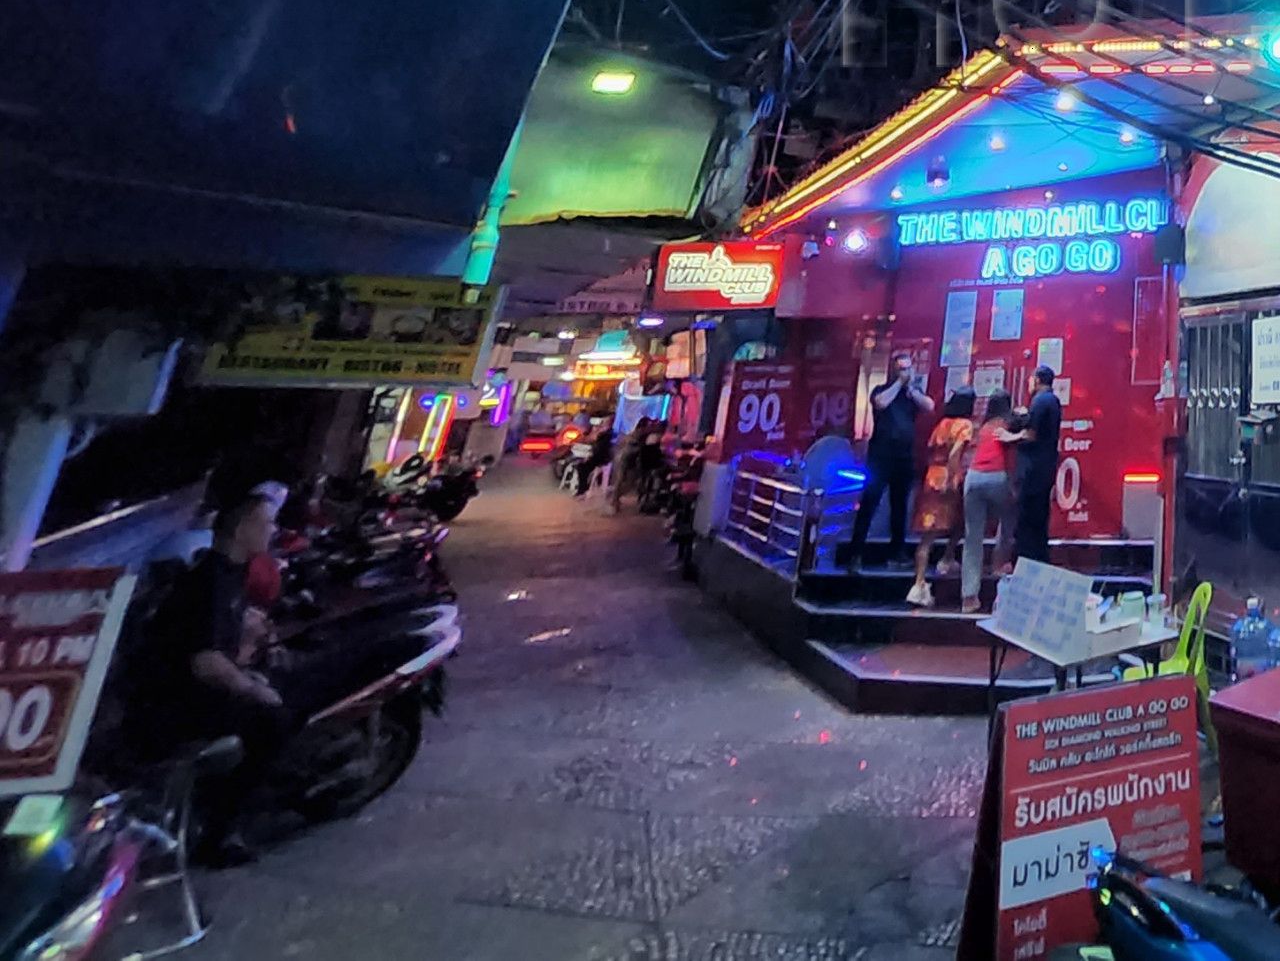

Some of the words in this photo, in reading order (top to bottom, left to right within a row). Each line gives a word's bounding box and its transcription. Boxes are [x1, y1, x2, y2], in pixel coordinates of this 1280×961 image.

[898, 212, 958, 246] THE
[961, 202, 1124, 242] WINDMILL
[667, 266, 771, 285] WINDMILL
[669, 254, 707, 269] THE
[981, 245, 1010, 279] A
[1011, 242, 1060, 277] GO
[1065, 238, 1119, 272] GO
[724, 283, 768, 295] CLUB
[18, 637, 50, 667] 10
[1015, 722, 1038, 739] THE
[1042, 712, 1101, 734] WINDMILL
[1105, 705, 1133, 722] CLUB
[1136, 704, 1145, 717] A
[1148, 700, 1167, 714] GO
[1170, 695, 1189, 710] GO
[1015, 768, 1191, 828] รับสมัครพนักงาน
